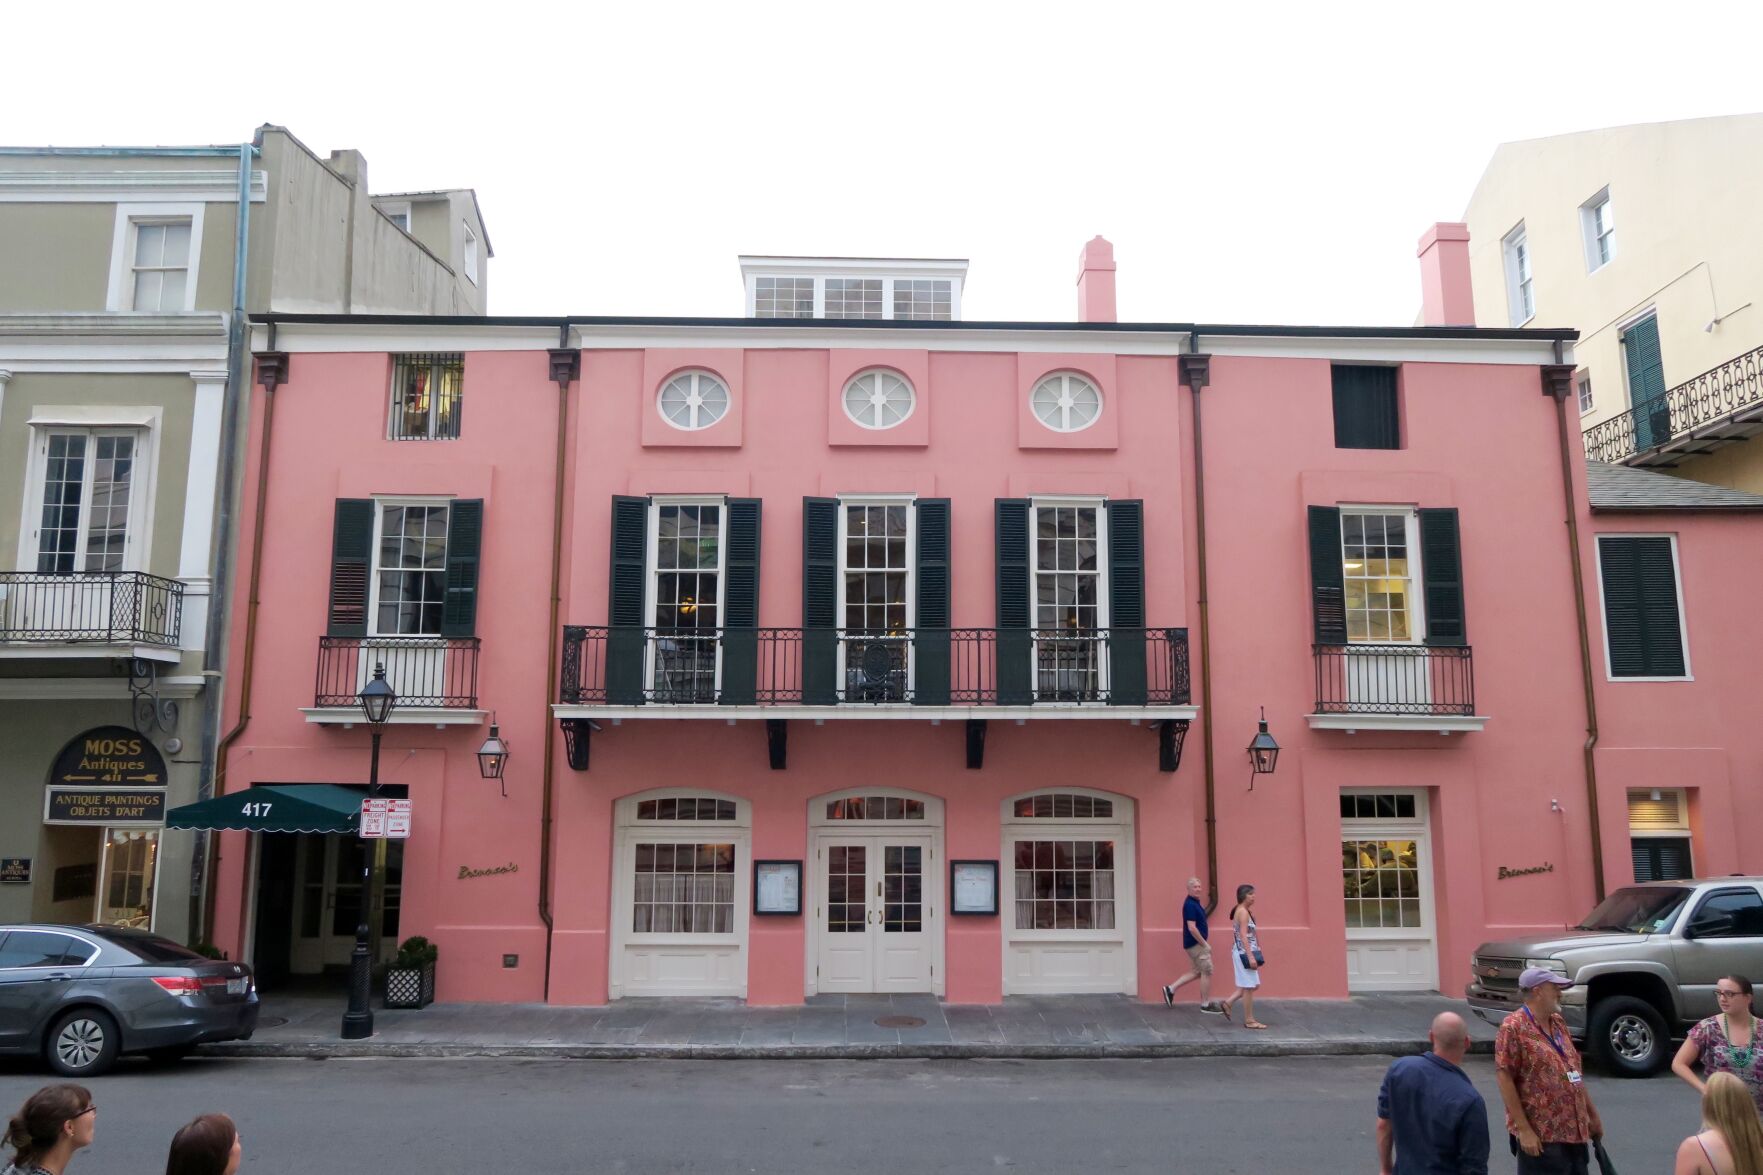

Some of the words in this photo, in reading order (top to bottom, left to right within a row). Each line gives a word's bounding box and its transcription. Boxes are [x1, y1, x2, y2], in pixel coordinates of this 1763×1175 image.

[85, 739, 143, 756] MOSS
[78, 757, 145, 774] Antiques
[101, 774, 122, 782] 411
[56, 795, 101, 806] ANTIQUE
[105, 795, 160, 806] PAINTINGS
[70, 806, 111, 816] OBJETS
[115, 807, 145, 817] D'ART
[241, 802, 273, 817] 417
[457, 861, 519, 880] Brennan's
[1497, 861, 1554, 881] Brennan's
